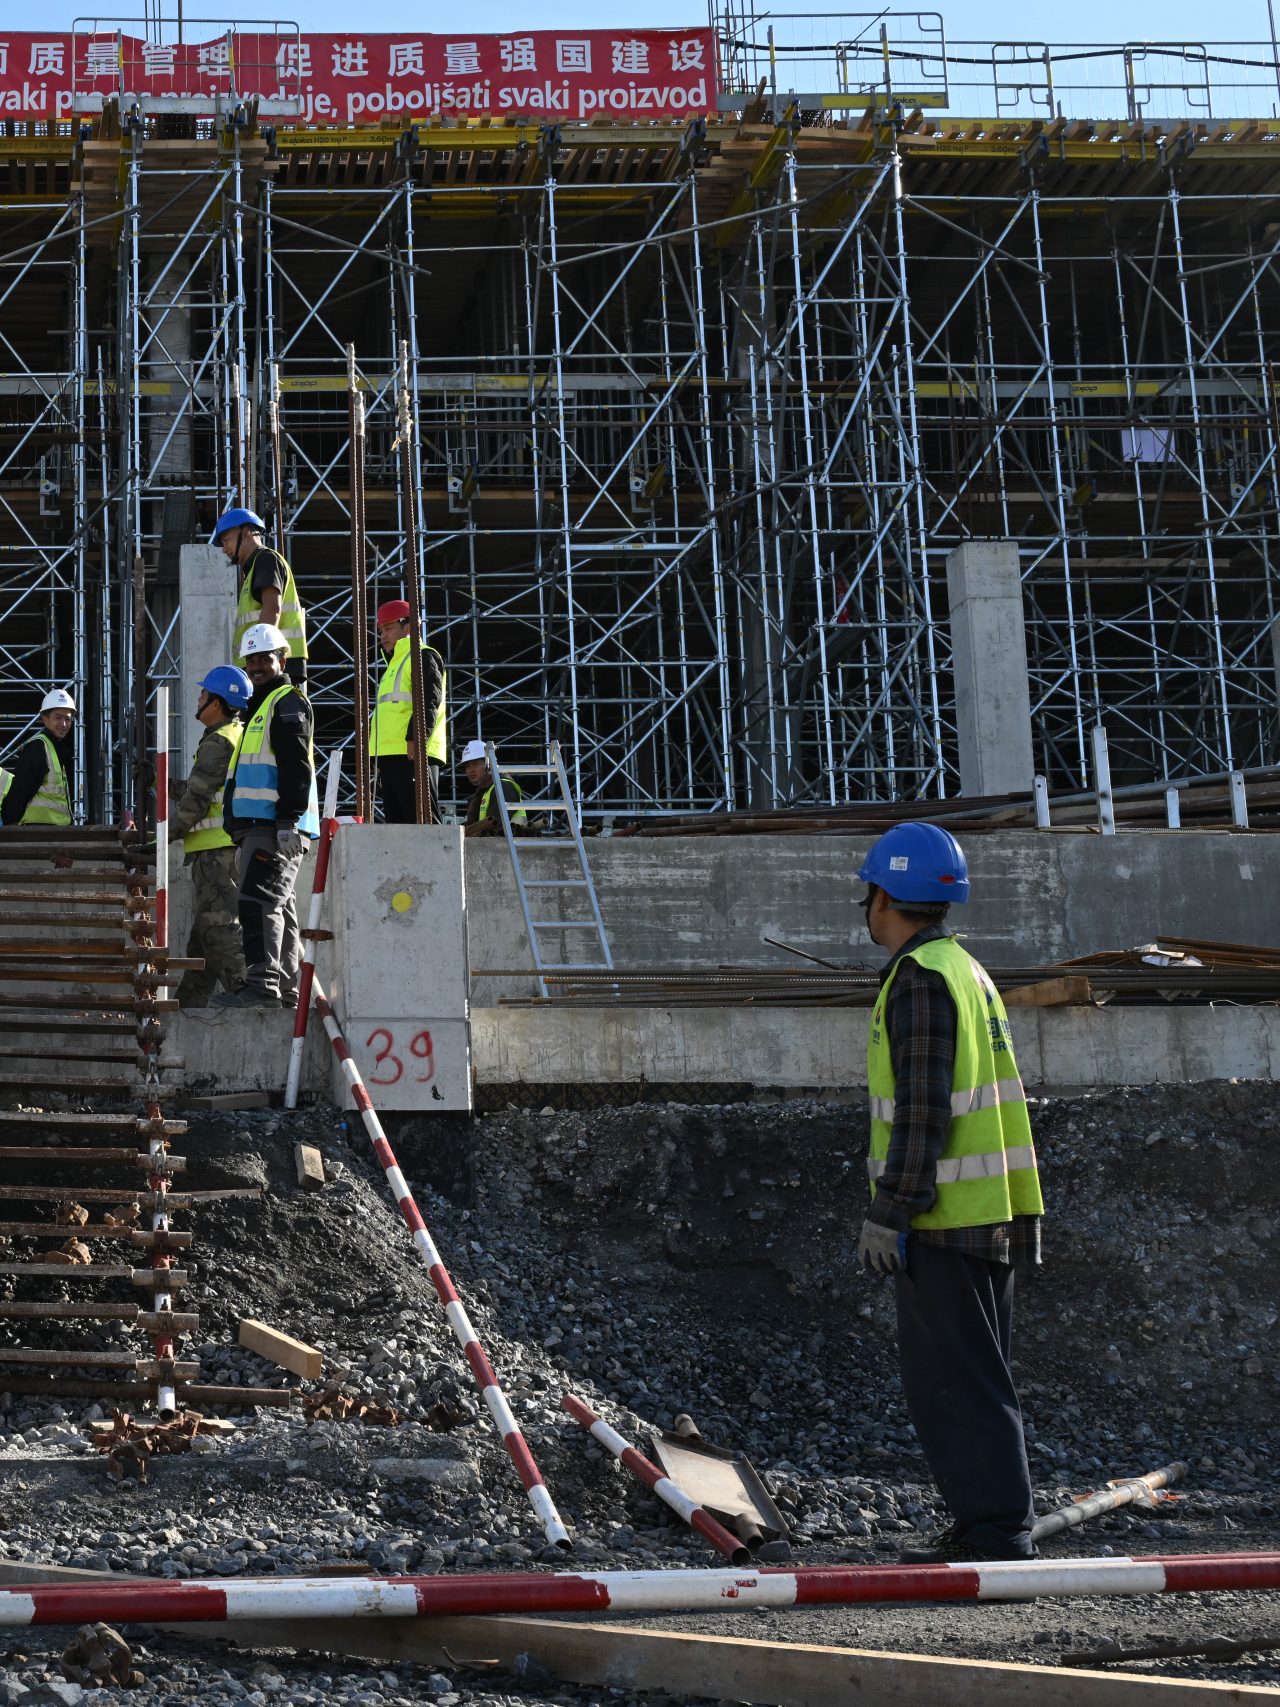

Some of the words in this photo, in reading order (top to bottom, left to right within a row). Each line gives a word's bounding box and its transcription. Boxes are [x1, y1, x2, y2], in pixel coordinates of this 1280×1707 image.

[275, 38, 706, 78] 促进质量强国建设
[347, 79, 491, 120] poboljšati
[499, 79, 570, 110] svaki
[579, 78, 707, 118] proizvod
[366, 1028, 435, 1085] 39
